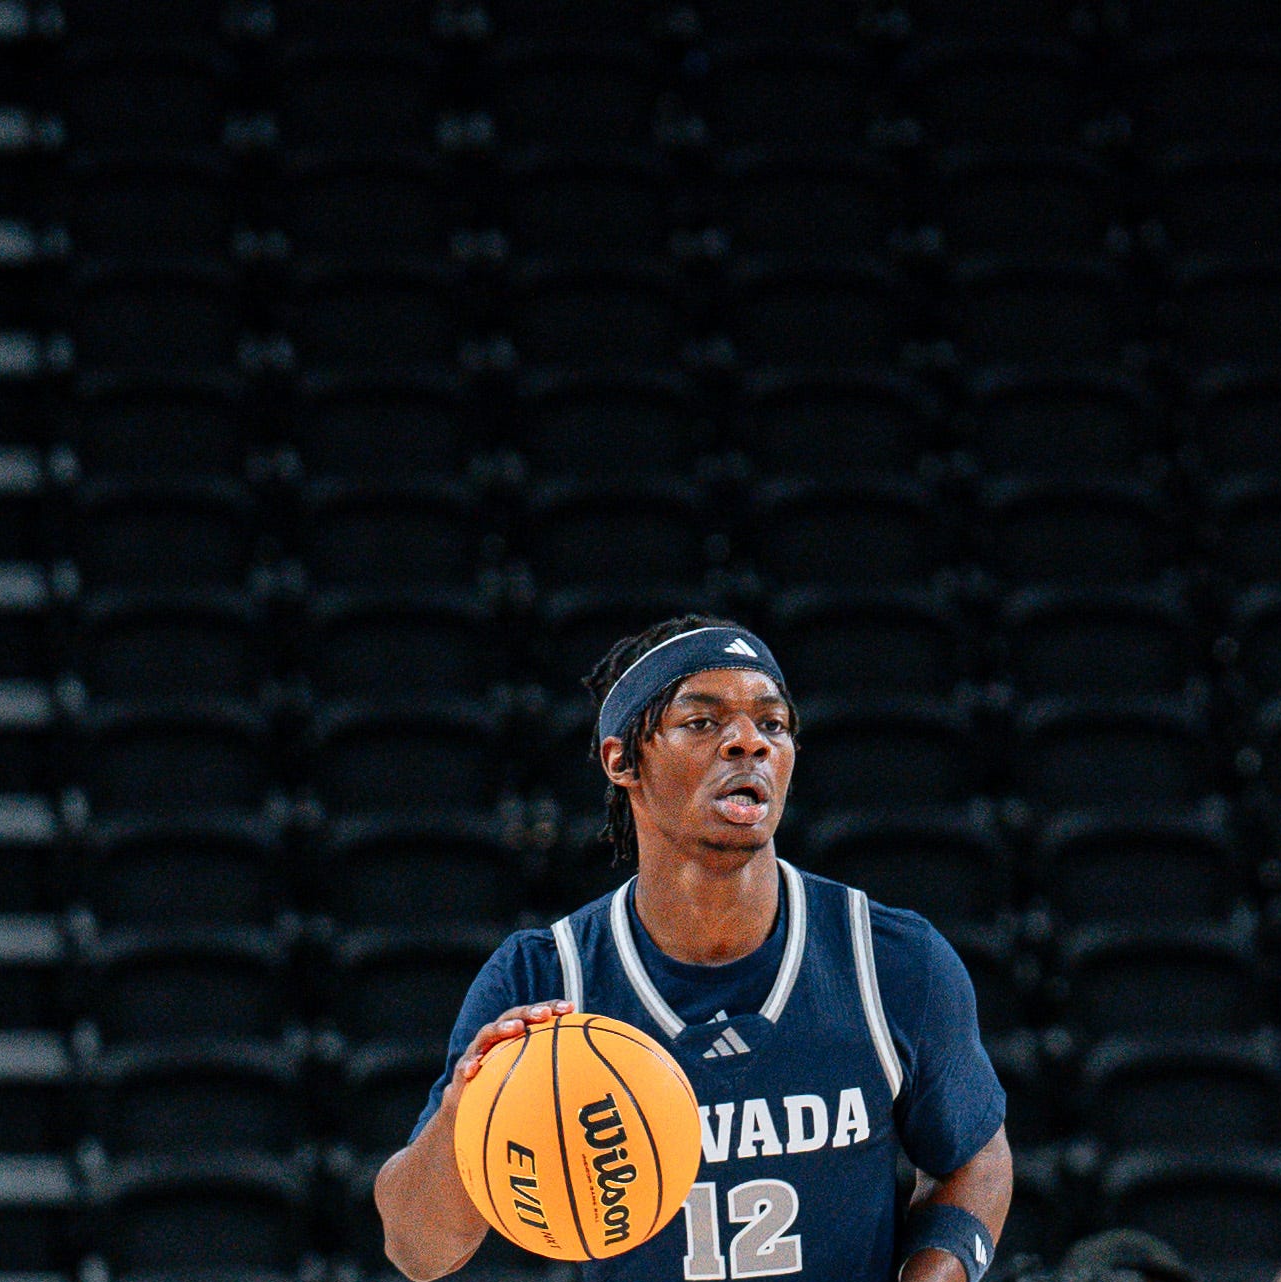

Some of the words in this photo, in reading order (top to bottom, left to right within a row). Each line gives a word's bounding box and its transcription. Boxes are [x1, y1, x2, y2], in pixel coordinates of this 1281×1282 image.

[507, 1140, 549, 1229] EVO
[541, 1231, 563, 1250] NXT
[578, 1092, 637, 1246] Wilson
[683, 1178, 803, 1281] 12
